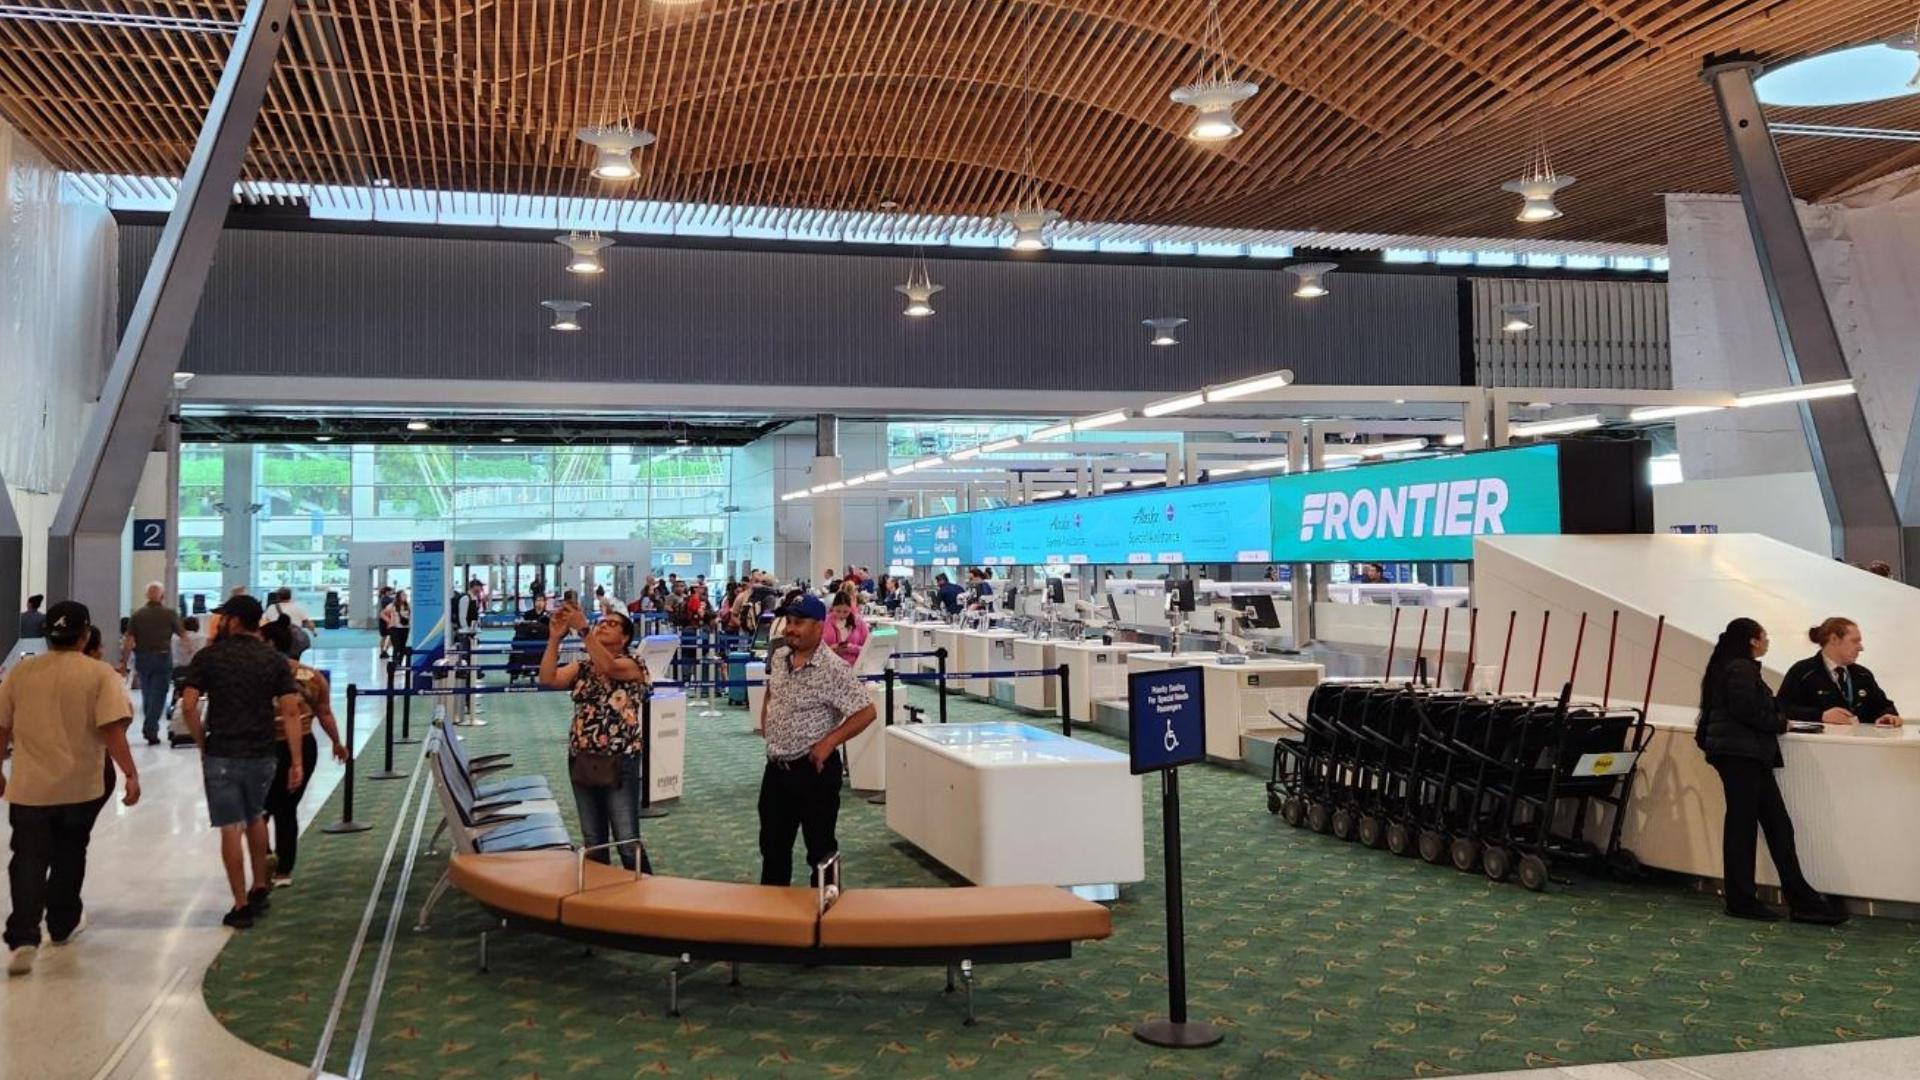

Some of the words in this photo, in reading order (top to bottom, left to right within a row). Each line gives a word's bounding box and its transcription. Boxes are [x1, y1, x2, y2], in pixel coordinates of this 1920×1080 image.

[1300, 477, 1509, 541] FRONTIER
[143, 523, 161, 547] 2
[1148, 696, 1157, 704] For
[1157, 694, 1174, 704] Special
[1156, 704, 1182, 713] Passengers
